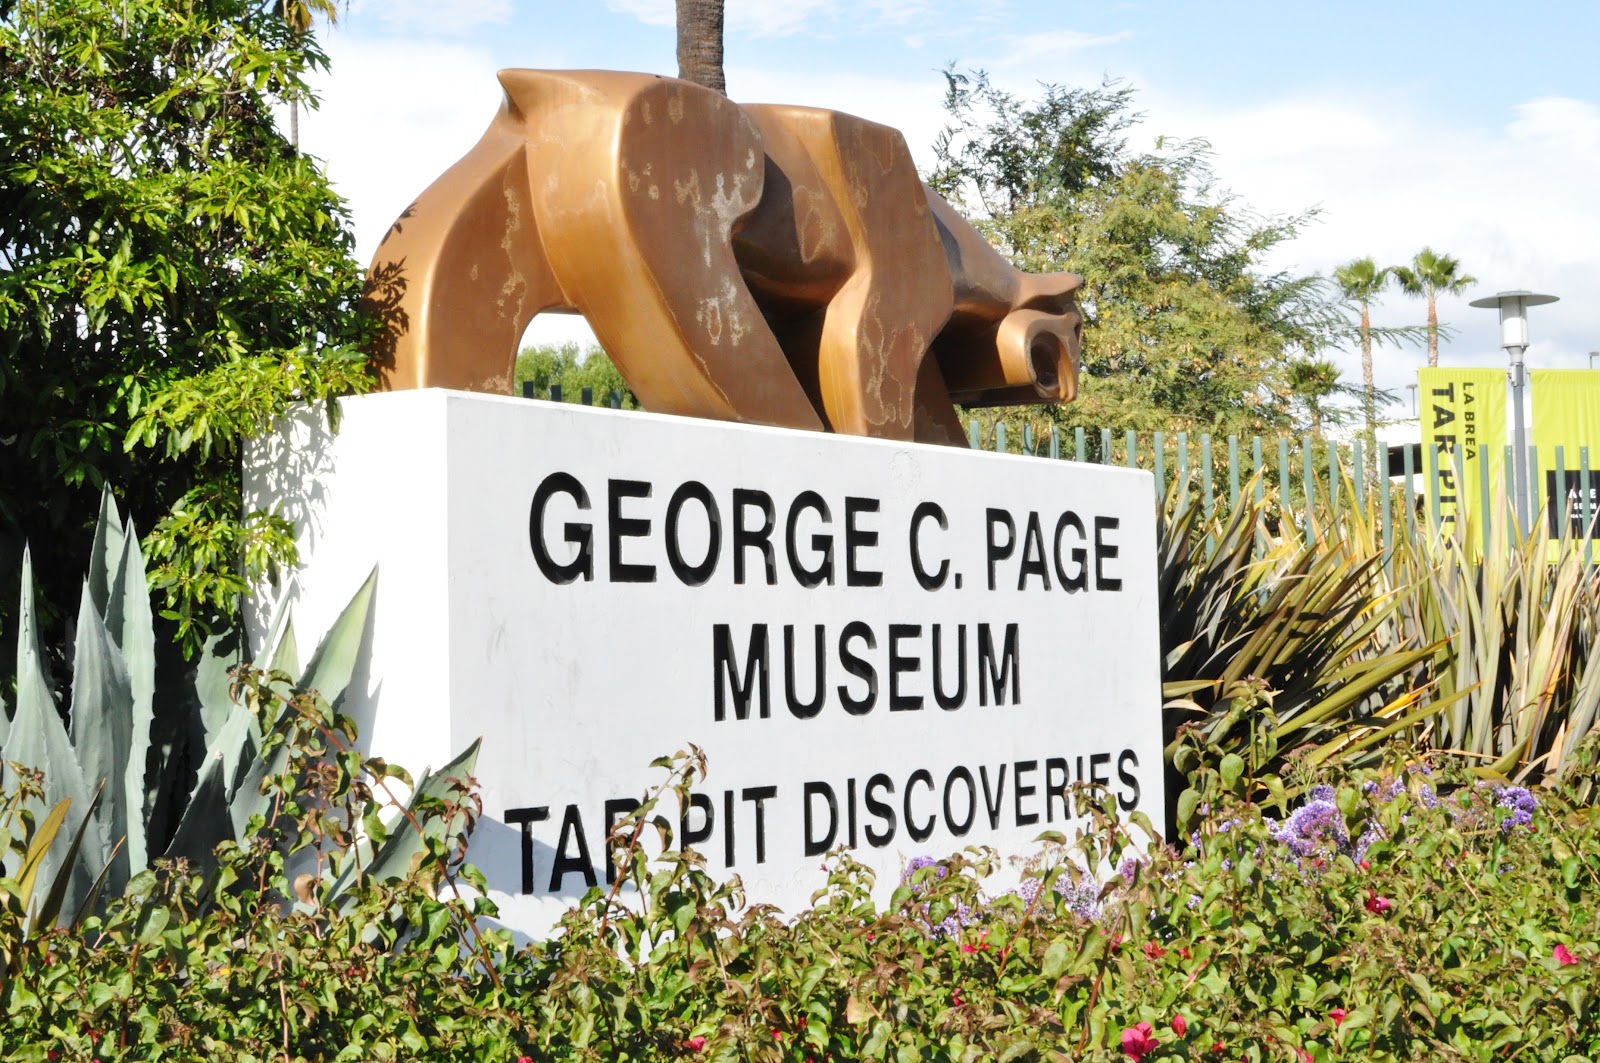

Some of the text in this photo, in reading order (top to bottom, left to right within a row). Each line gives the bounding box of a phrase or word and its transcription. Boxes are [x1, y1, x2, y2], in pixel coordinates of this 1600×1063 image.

[1431, 382, 1456, 454] TAR
[1462, 382, 1476, 460] LA BREA
[529, 471, 1123, 596] GEORGE C. PAGE
[713, 620, 1022, 723] MUSEUM
[680, 785, 777, 868] PIT
